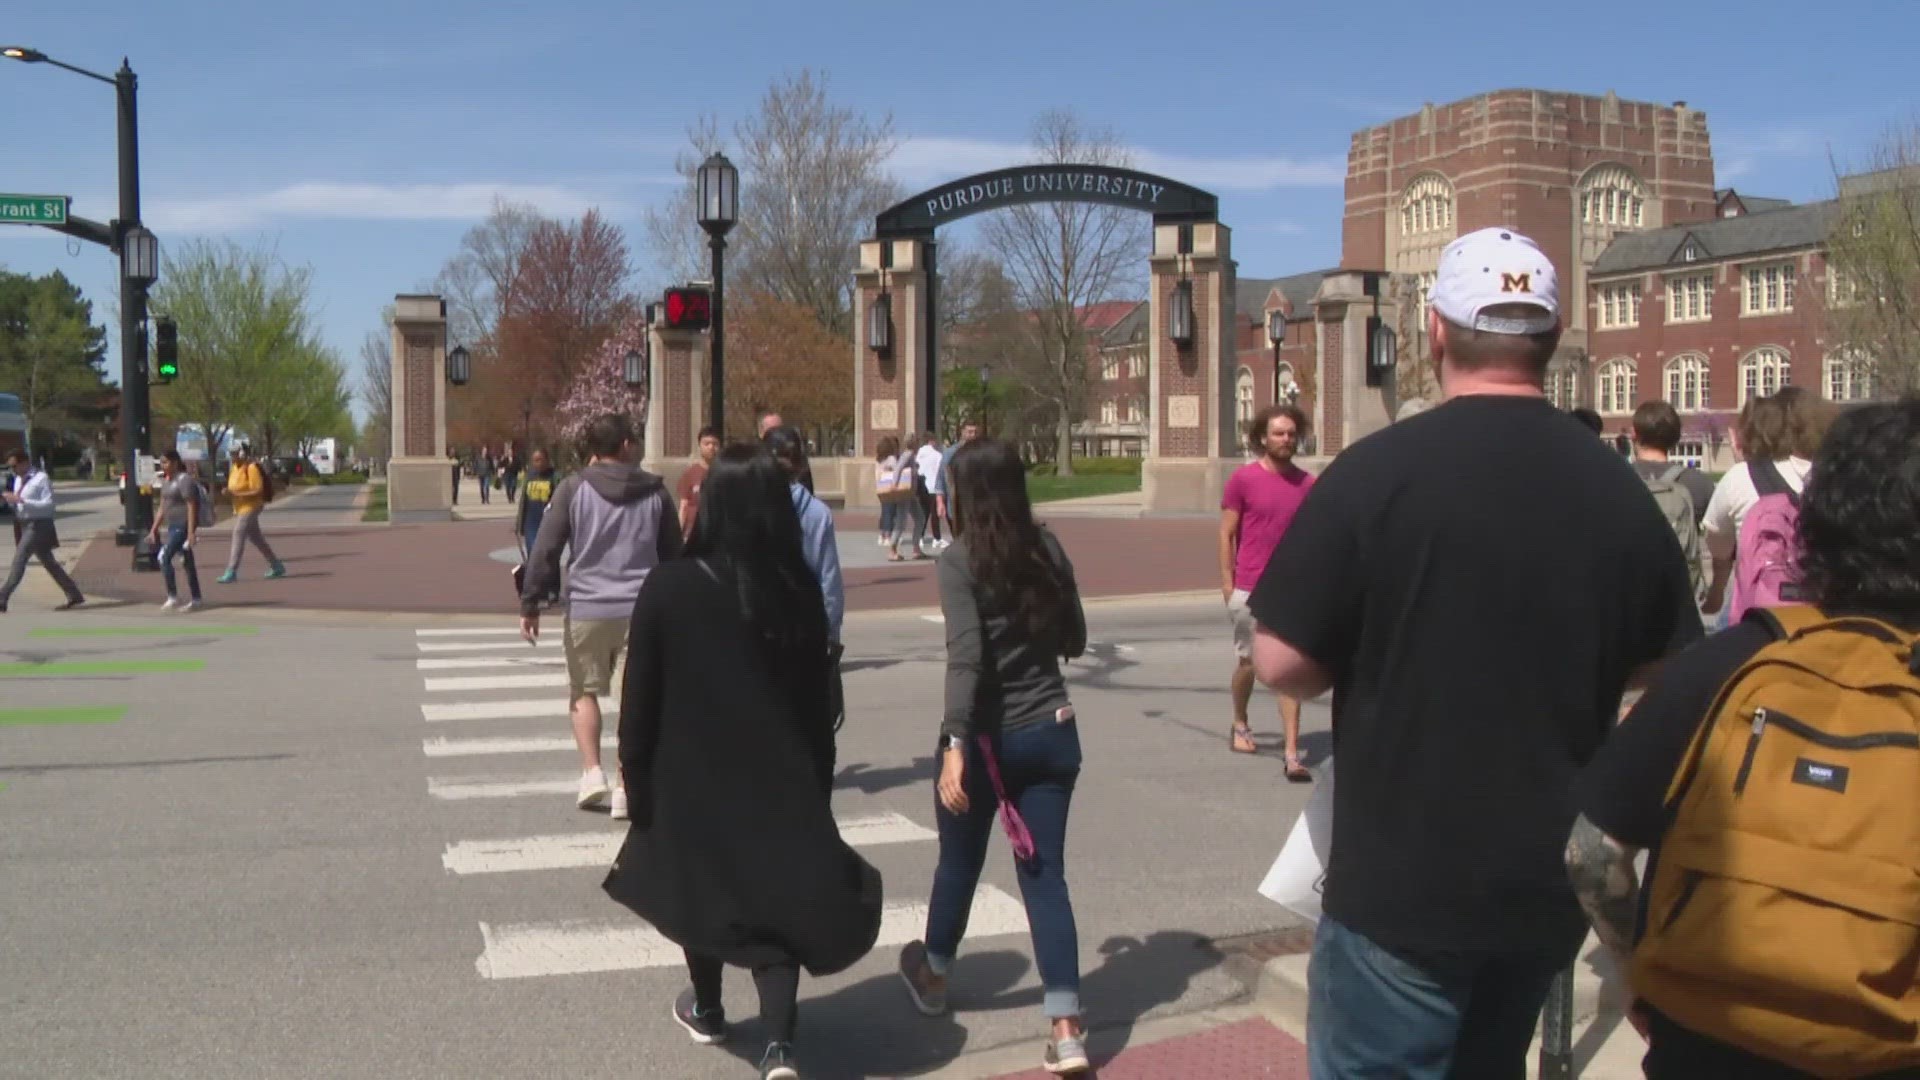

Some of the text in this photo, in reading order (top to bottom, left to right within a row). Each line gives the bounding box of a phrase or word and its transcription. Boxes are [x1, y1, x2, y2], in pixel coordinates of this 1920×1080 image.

[926, 172, 1166, 217] PURDUE UNIVERSITY
[0, 202, 61, 219] rant St
[1500, 271, 1532, 293] M
